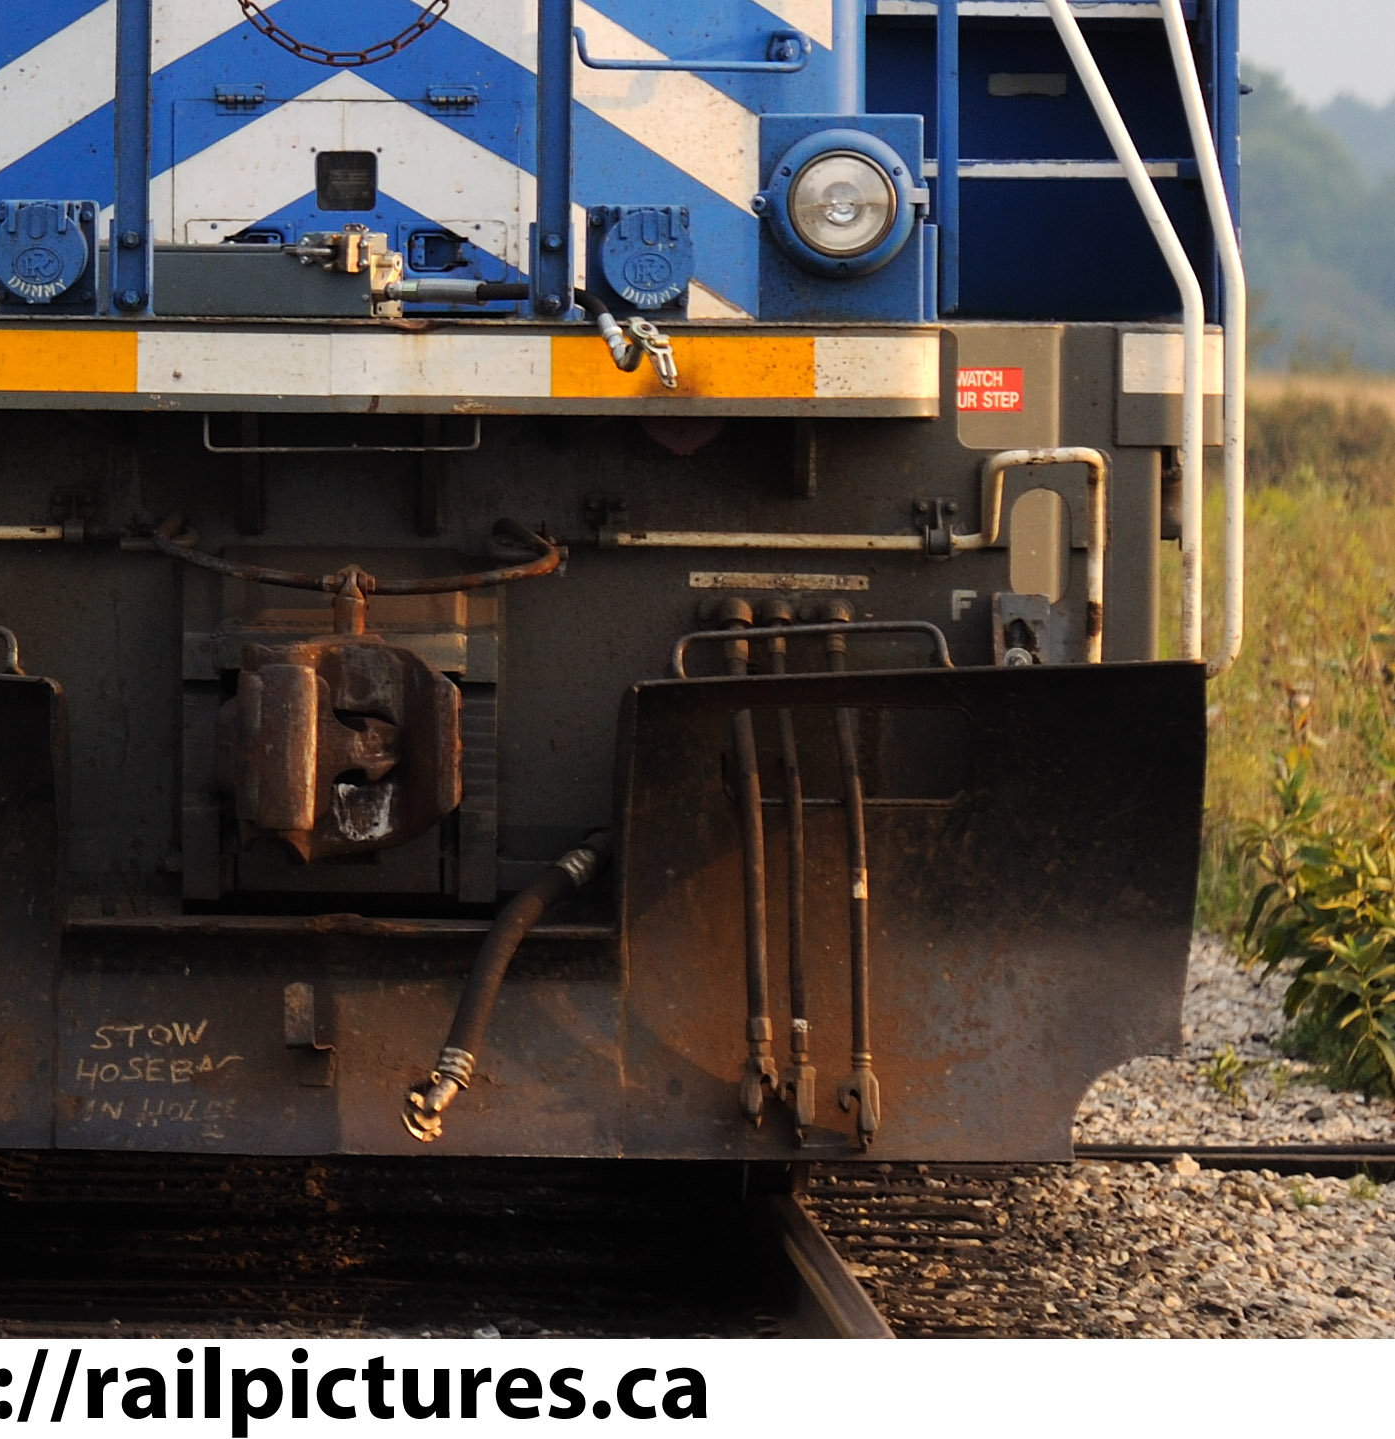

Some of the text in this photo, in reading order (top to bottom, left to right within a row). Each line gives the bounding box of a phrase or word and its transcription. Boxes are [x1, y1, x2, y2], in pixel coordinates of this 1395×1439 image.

[8, 275, 67, 298] DUMMY
[621, 282, 681, 305] DUMMY
[957, 370, 1003, 387] WATCH
[957, 391, 1020, 408] UR STEP
[952, 589, 978, 621] F
[90, 1019, 208, 1050] STOW
